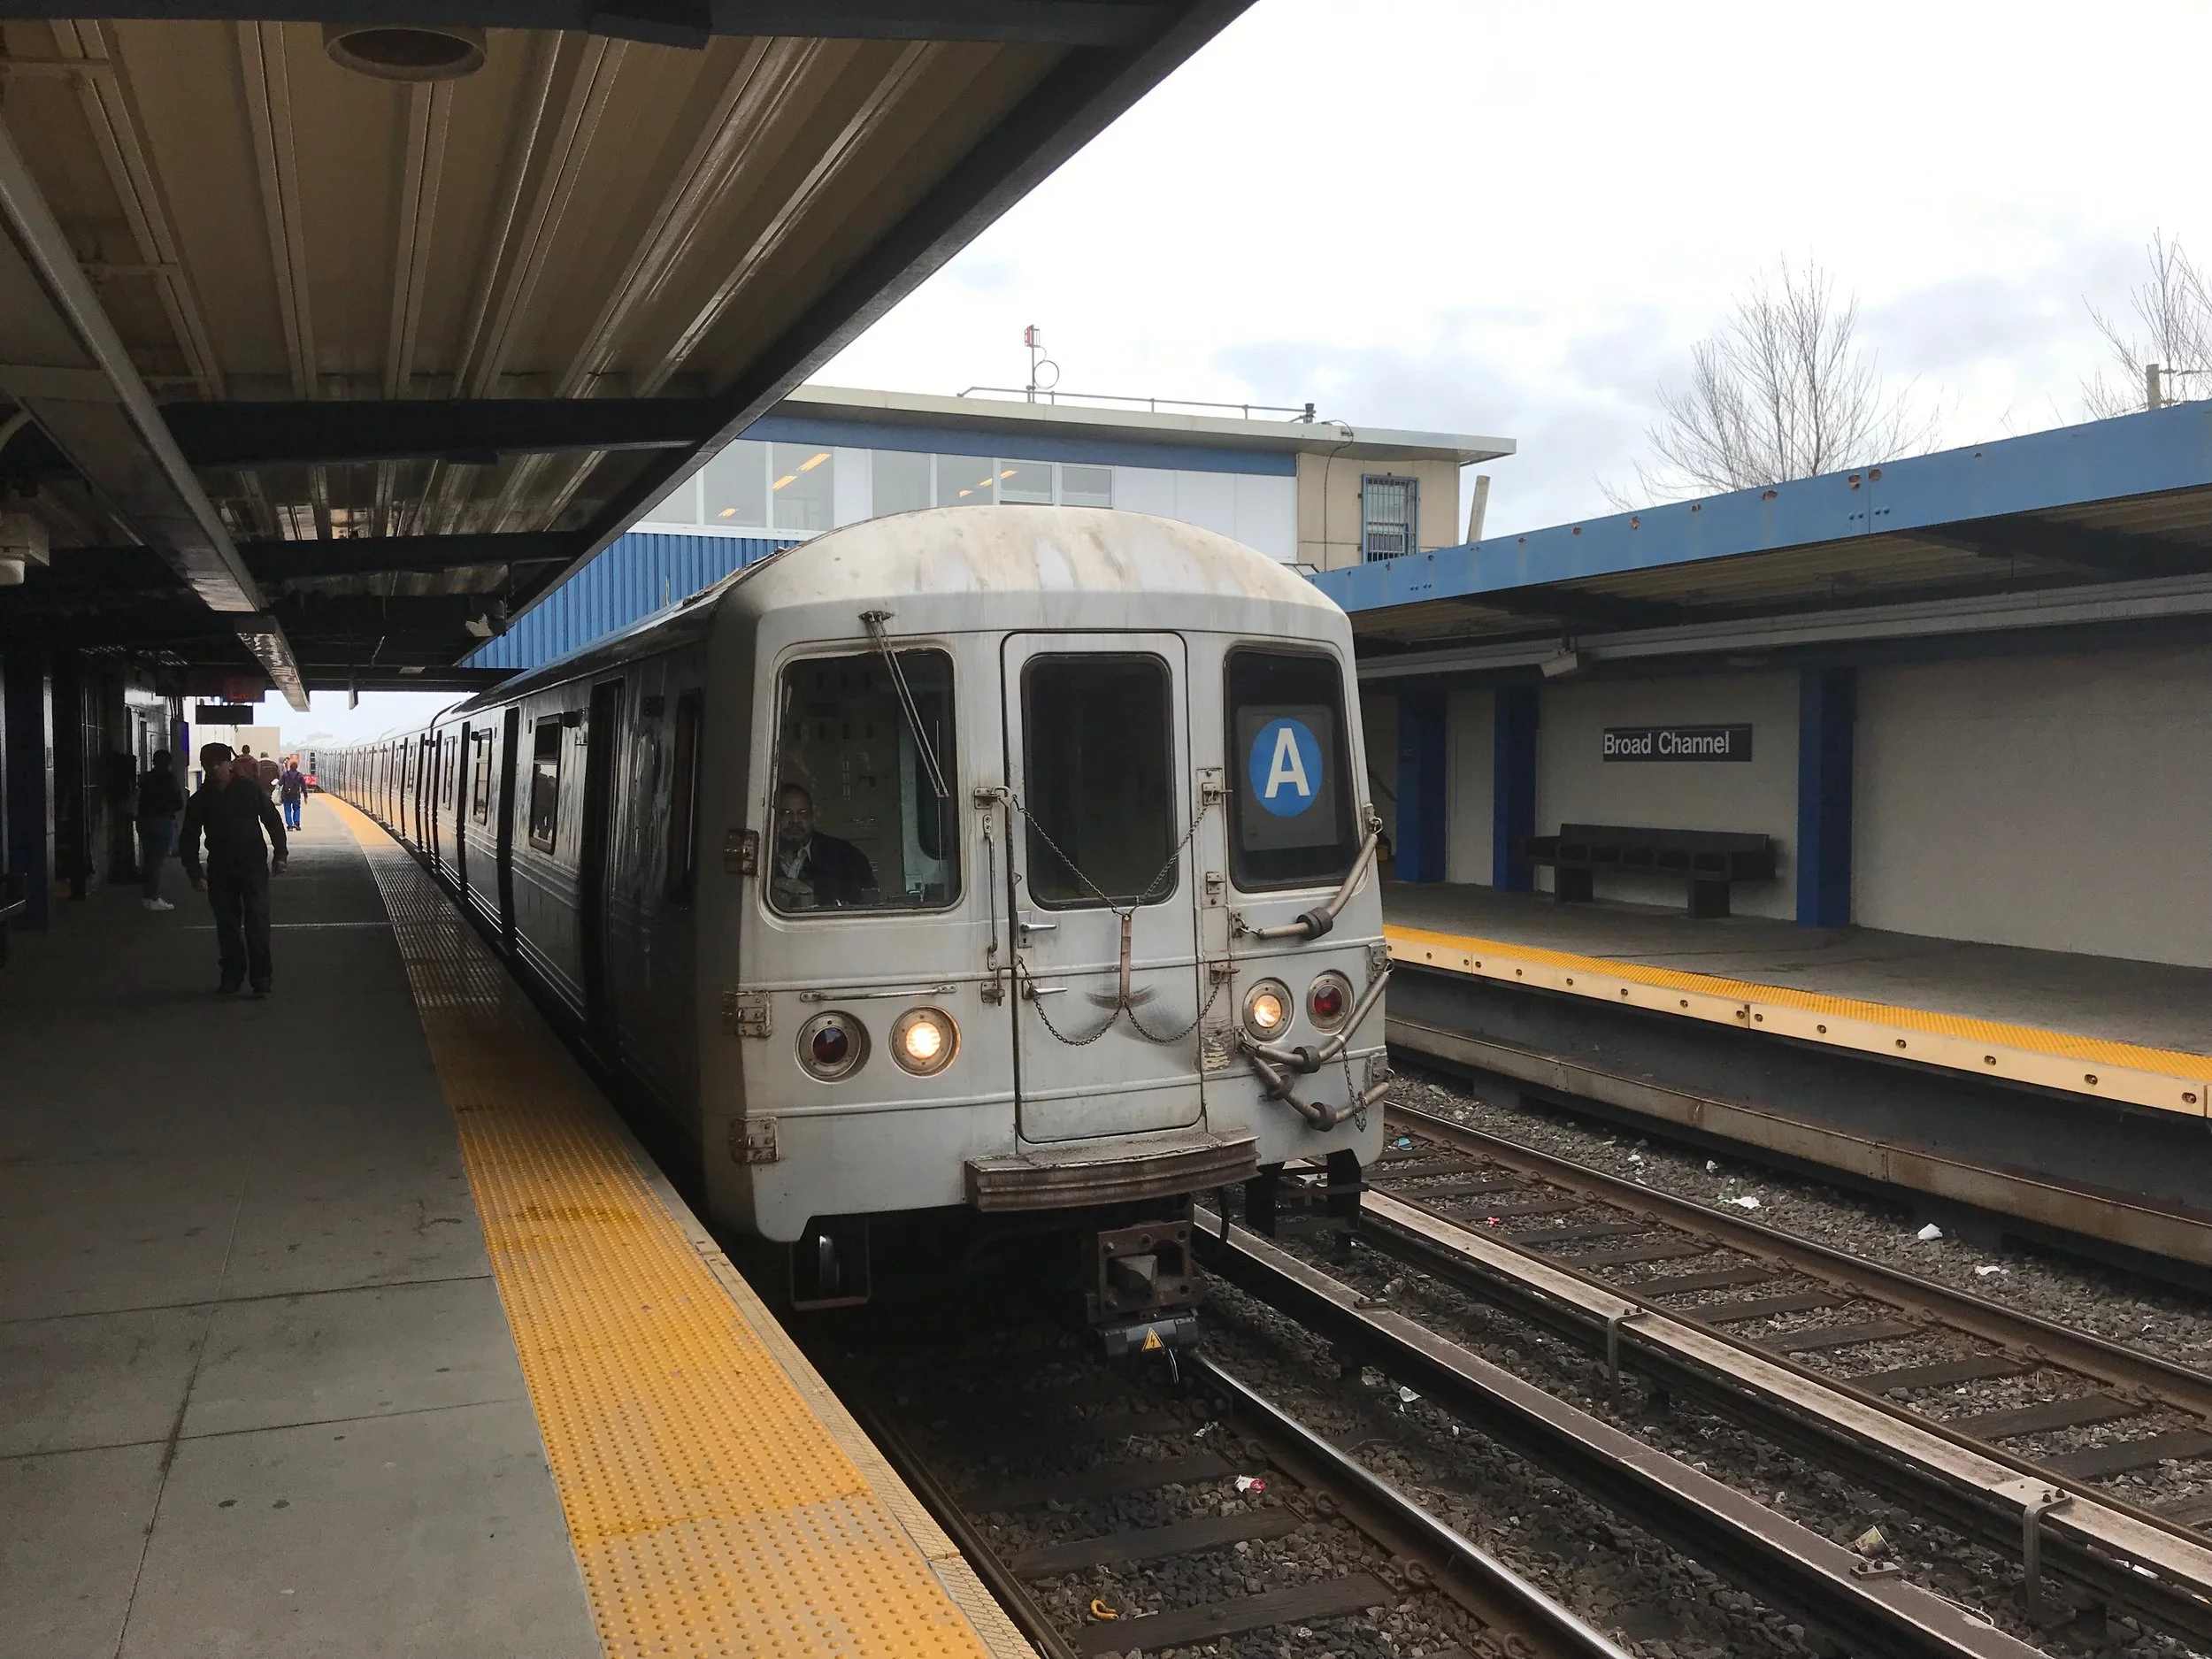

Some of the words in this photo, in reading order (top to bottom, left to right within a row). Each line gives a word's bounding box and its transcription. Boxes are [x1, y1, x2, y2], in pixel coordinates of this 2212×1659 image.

[1264, 727, 1310, 799] A
[1604, 733, 1652, 754] Broad
[1658, 731, 1730, 754] Channel
